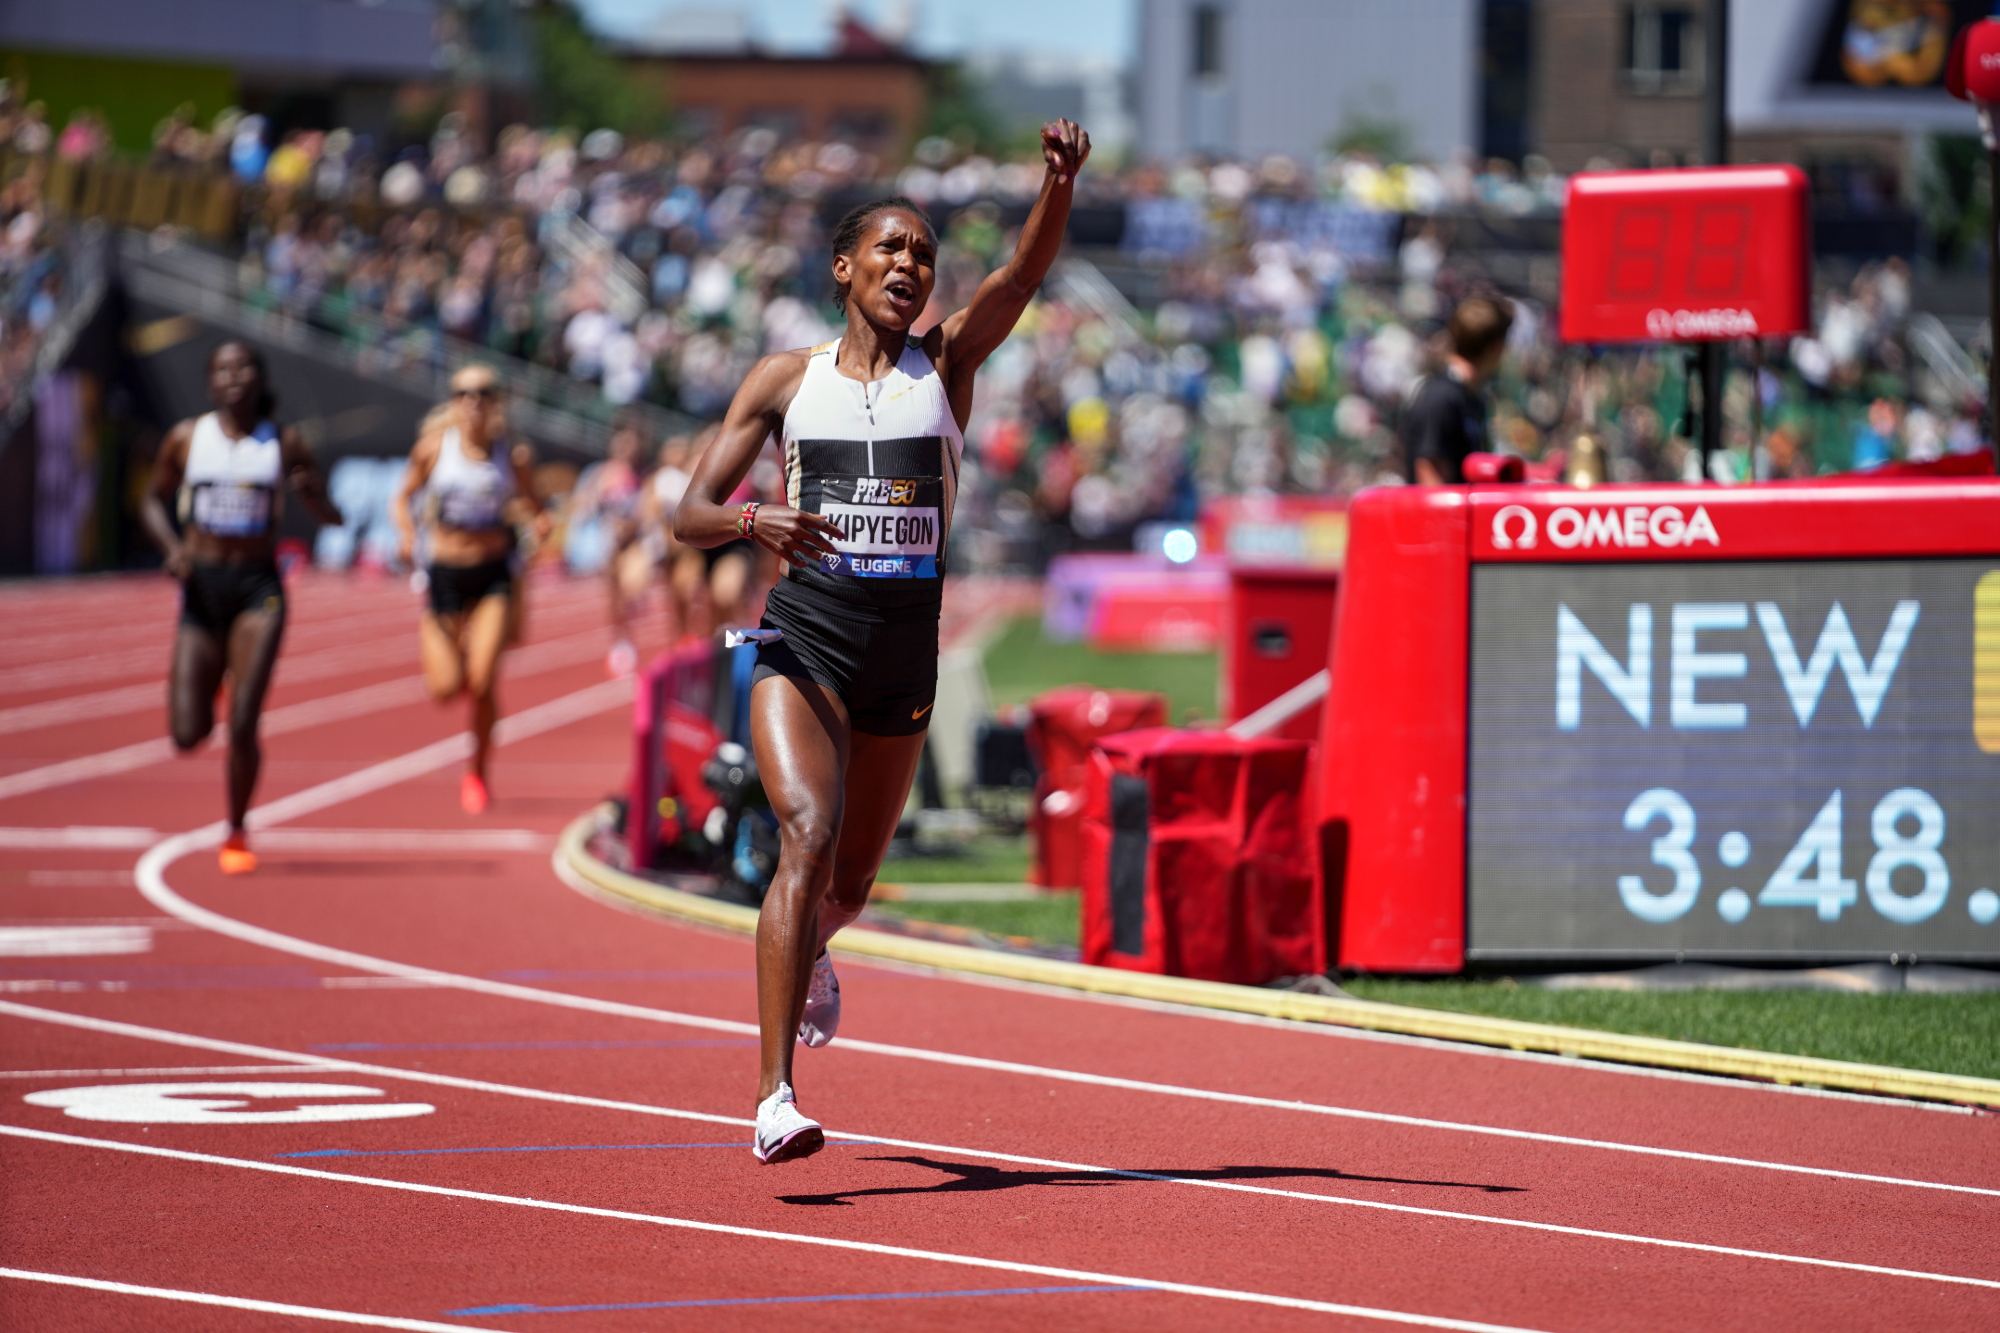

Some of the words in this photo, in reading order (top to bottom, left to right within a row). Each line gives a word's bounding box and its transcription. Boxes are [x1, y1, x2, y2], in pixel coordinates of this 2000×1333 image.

[1672, 307, 1759, 337] OMEGA
[828, 513, 933, 545] KIPYEGON
[1546, 505, 1720, 548] OMEGA
[851, 558, 911, 573] EUGENE
[1556, 600, 1921, 732] NEW
